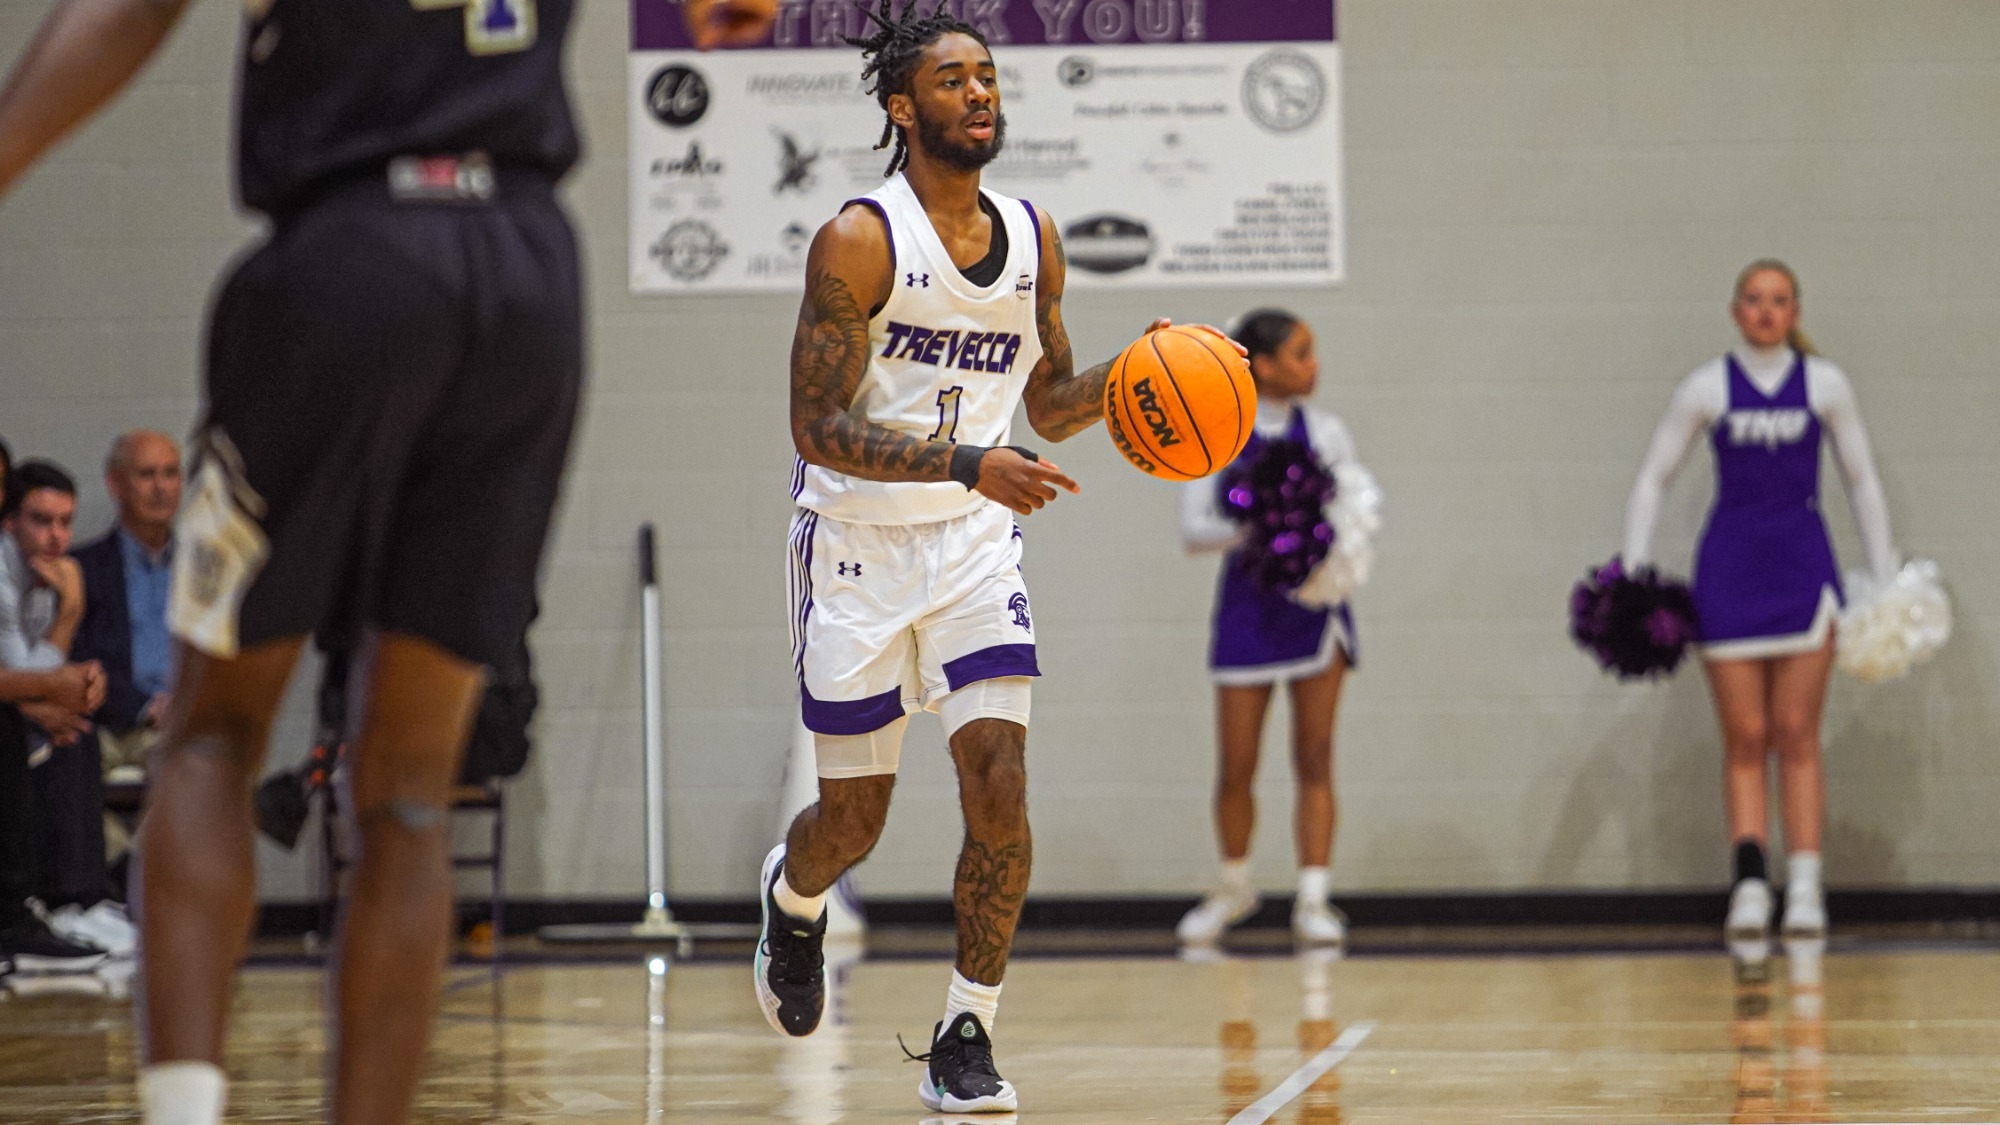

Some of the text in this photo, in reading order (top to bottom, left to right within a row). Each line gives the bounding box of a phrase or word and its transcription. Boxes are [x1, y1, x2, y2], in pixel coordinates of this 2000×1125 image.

[1033, 0, 1208, 44] YOU!
[880, 321, 1022, 375] TREVECCA
[928, 385, 963, 445] 1
[1133, 377, 1181, 448] NCAA
[1728, 409, 1810, 454] TNU
